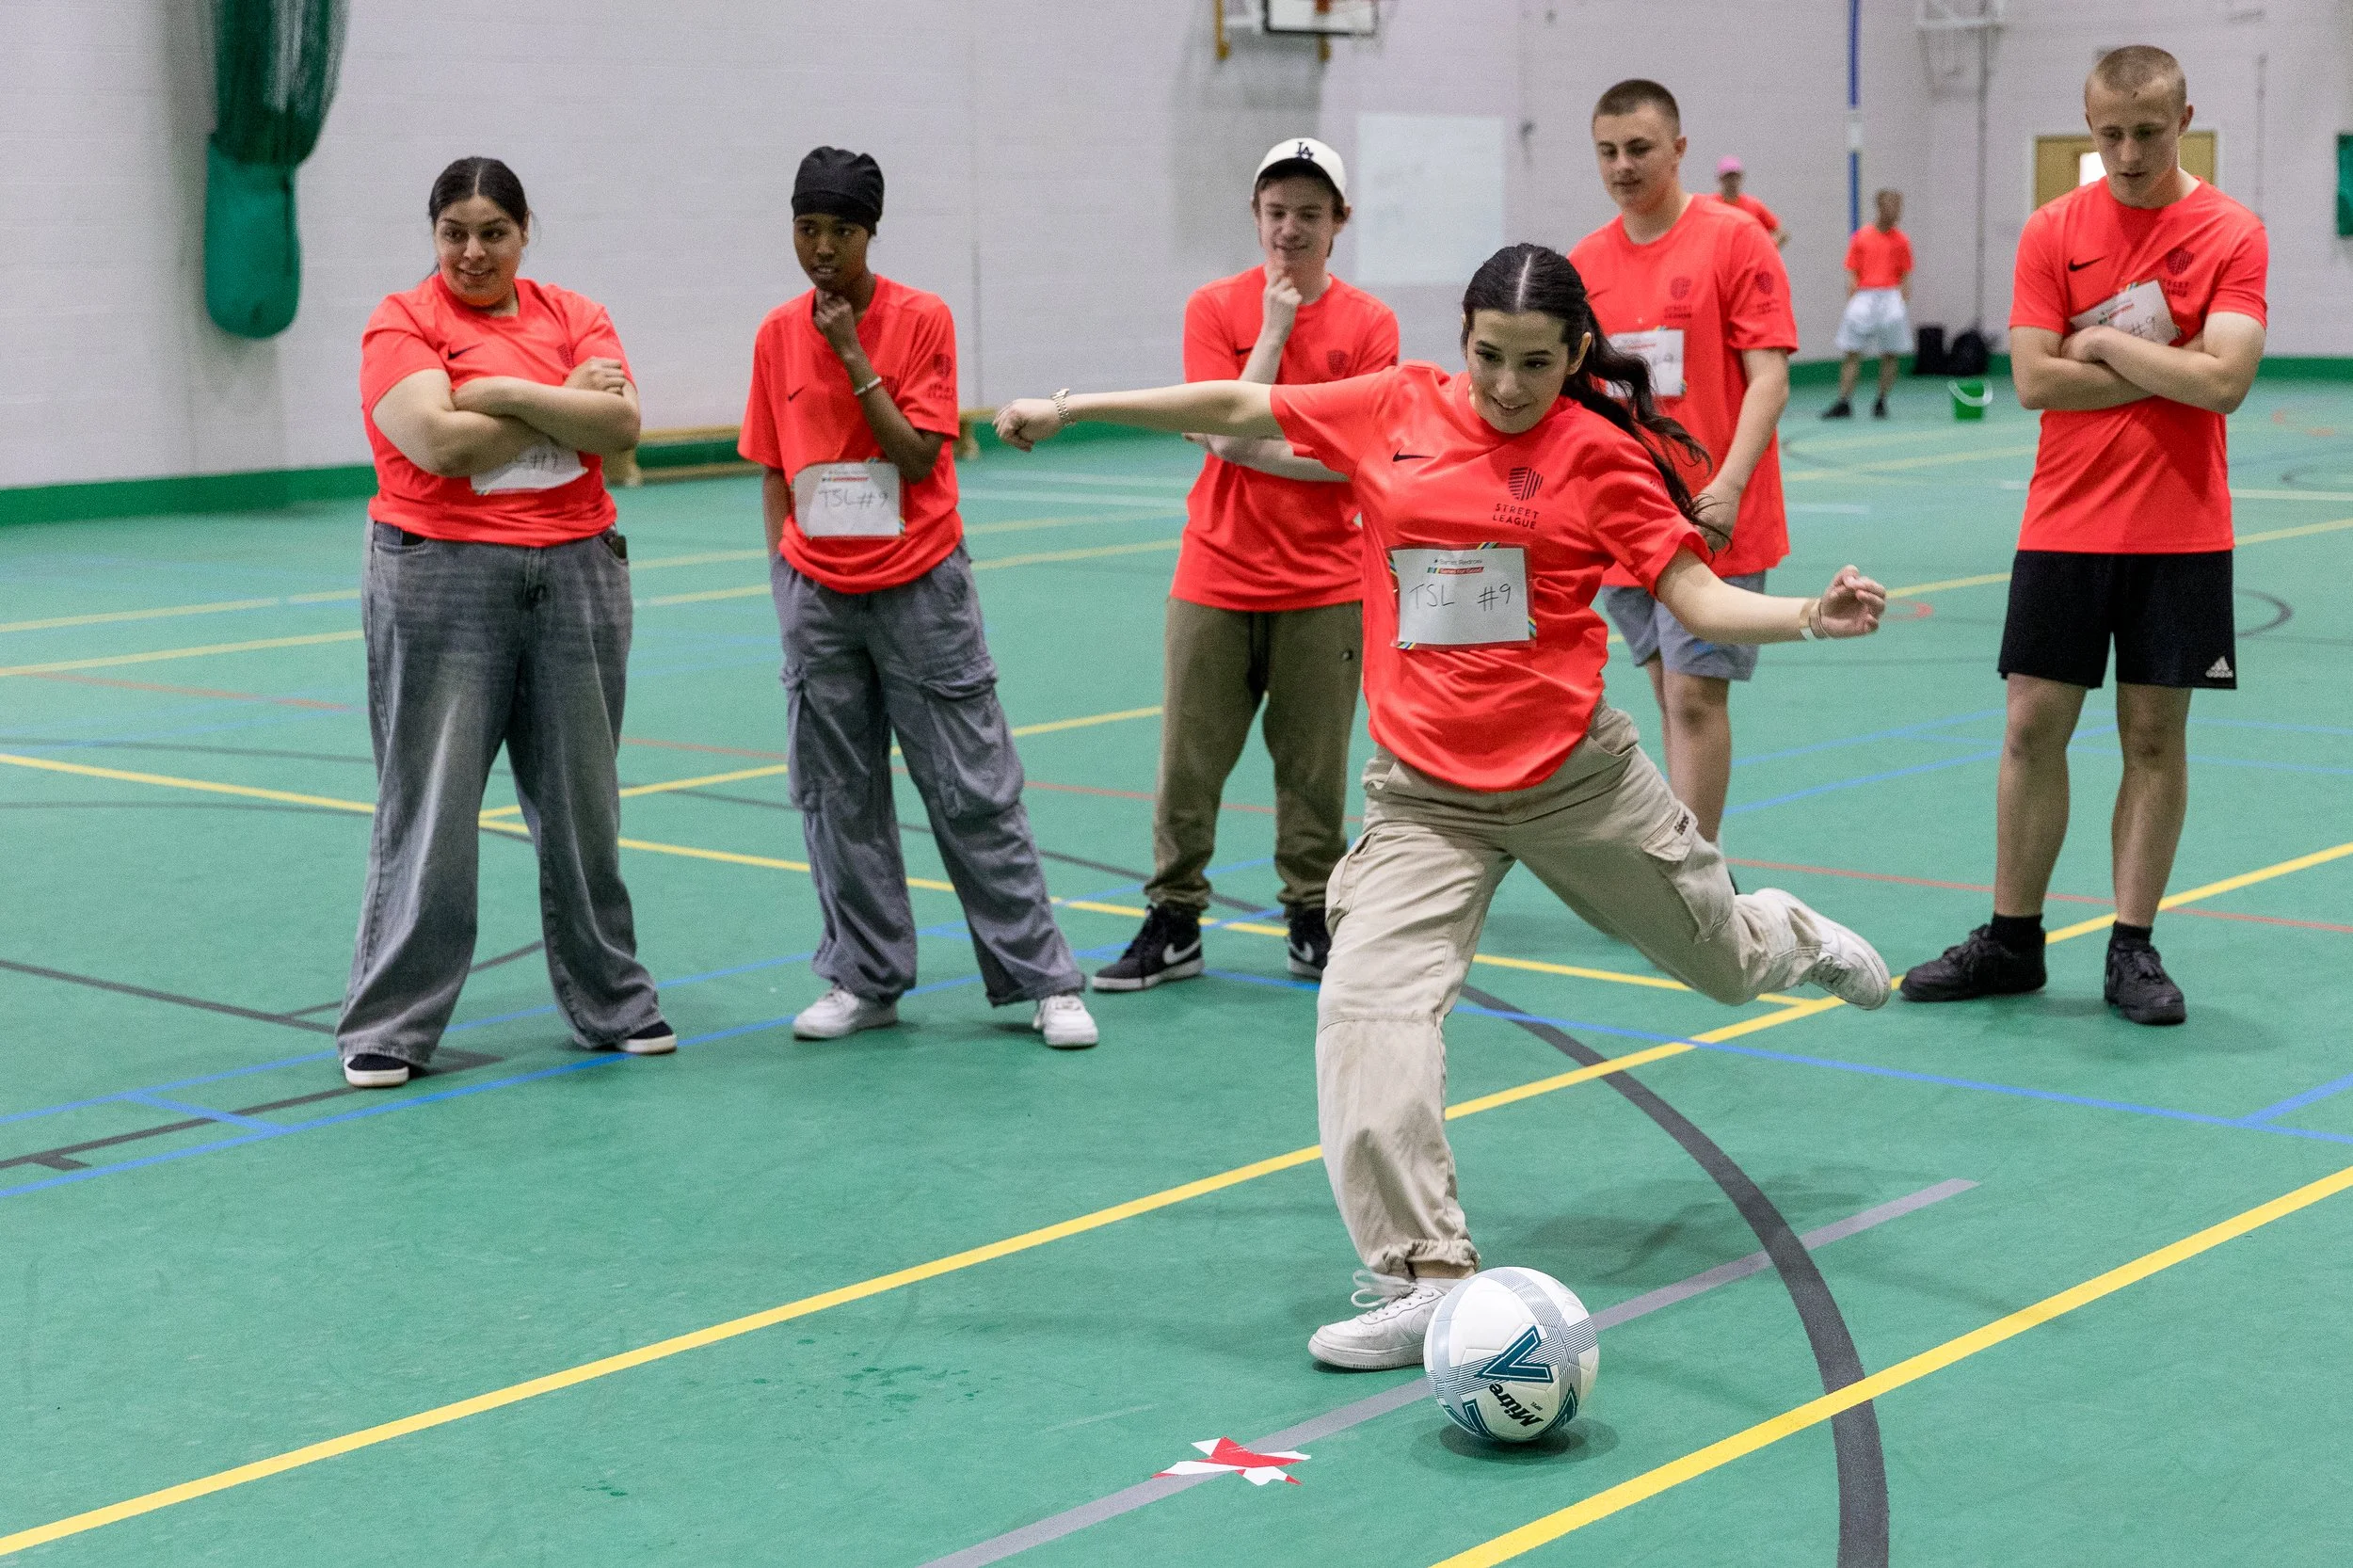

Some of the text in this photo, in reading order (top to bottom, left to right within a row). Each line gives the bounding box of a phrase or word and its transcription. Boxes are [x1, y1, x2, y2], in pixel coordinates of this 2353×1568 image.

[1296, 141, 1314, 160] LA
[1495, 503, 1540, 520] STREET
[1492, 514, 1537, 530] LEAGUE
[1409, 583, 1512, 612] TSL #9
[1489, 1383, 1545, 1427] Mitre
